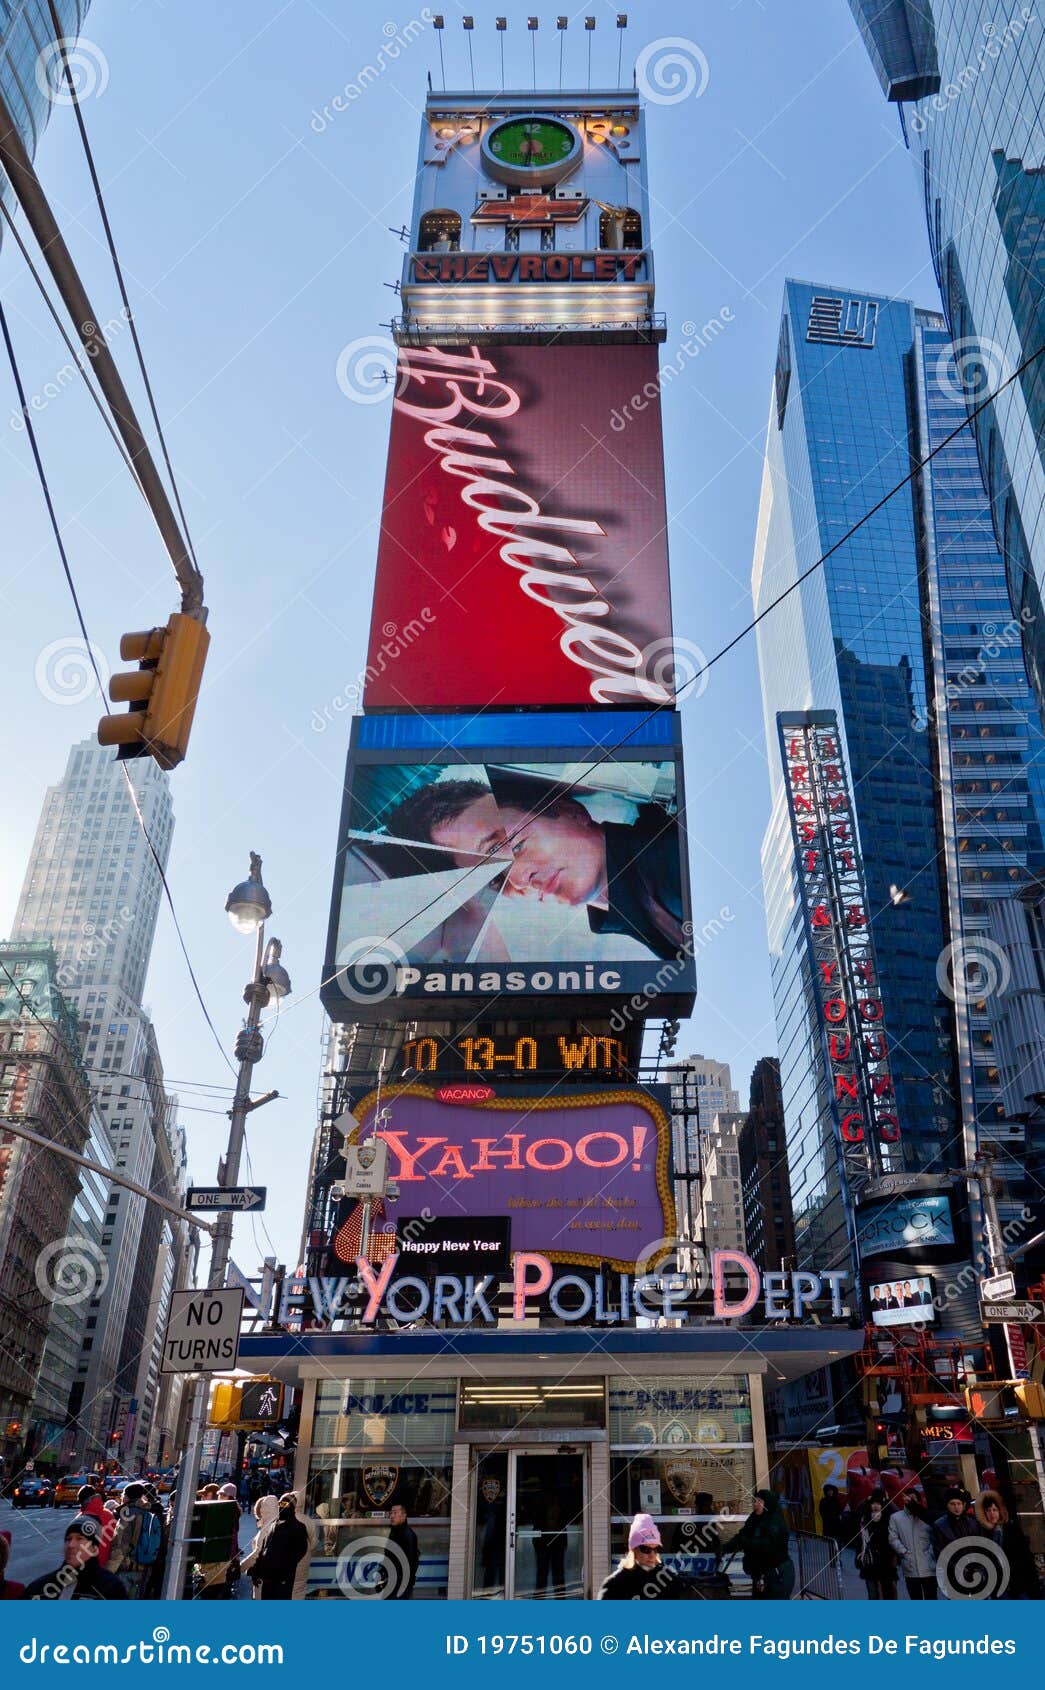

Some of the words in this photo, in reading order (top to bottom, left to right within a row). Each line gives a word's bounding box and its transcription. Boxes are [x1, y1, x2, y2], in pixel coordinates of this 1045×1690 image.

[414, 255, 642, 282] CHEVROLET
[789, 738, 820, 872] ERNST
[812, 905, 830, 925] &
[395, 965, 621, 992] Panasonic
[458, 1037, 537, 1070] 13-0
[819, 961, 864, 1143] YOUNG
[440, 1089, 491, 1099] VACANCY
[371, 1126, 647, 1181] YAHOO!
[197, 1194, 220, 1204] ONE
[230, 1194, 254, 1204] WAY
[402, 1241, 440, 1253] Happy
[442, 1240, 470, 1251] New
[472, 1240, 501, 1251] Year
[226, 1256, 349, 1323] NEW
[354, 1253, 494, 1323] YORK
[512, 1252, 688, 1321] POLICE
[710, 1248, 848, 1319] DEPT
[186, 1300, 223, 1326] NO
[990, 1307, 1009, 1316] ONE
[1017, 1307, 1036, 1316] WAY
[167, 1337, 234, 1361] TURNS
[344, 1393, 429, 1415] POLICE
[635, 1389, 724, 1411] POLICE
